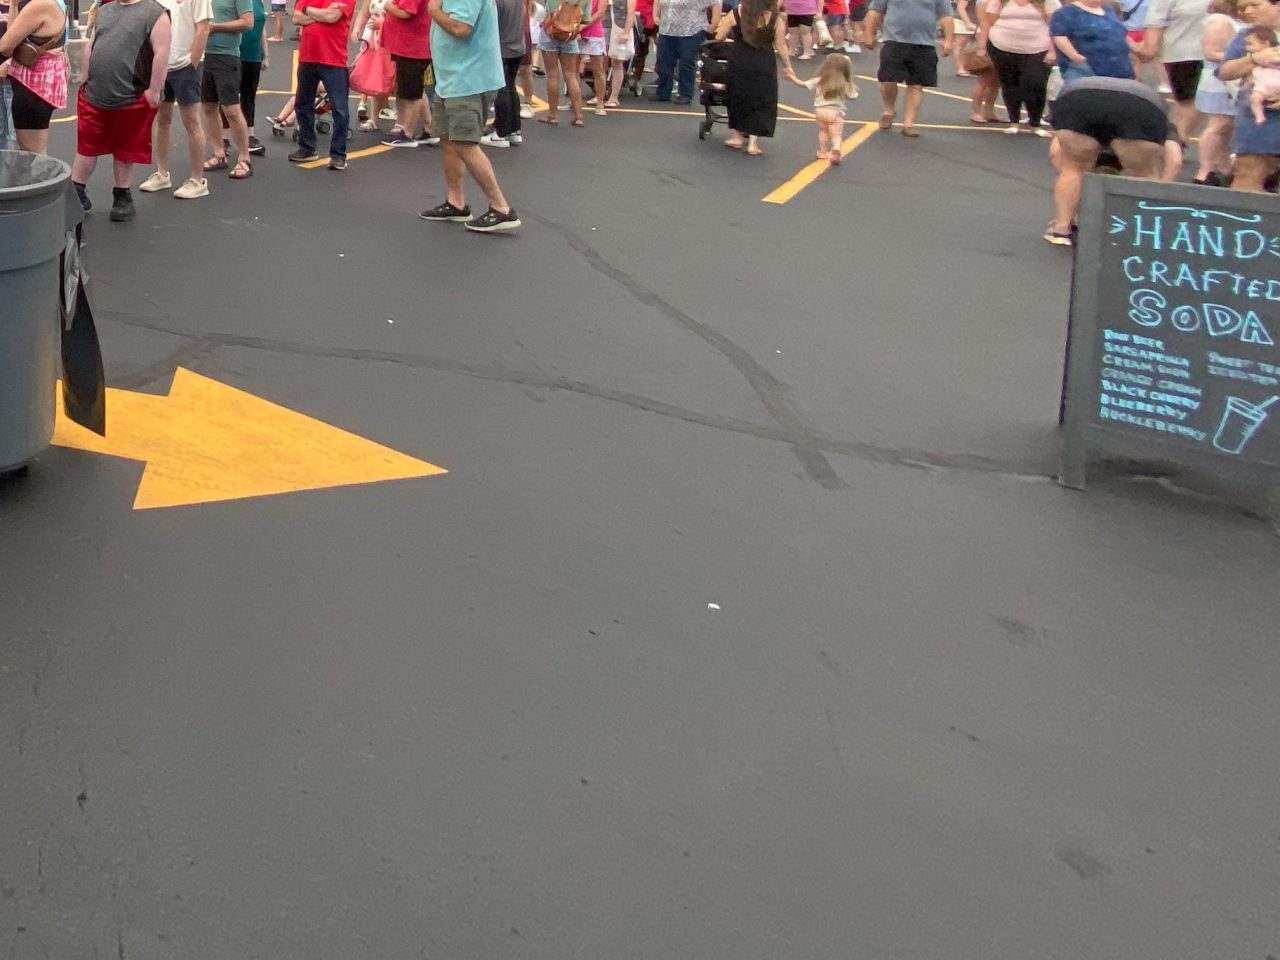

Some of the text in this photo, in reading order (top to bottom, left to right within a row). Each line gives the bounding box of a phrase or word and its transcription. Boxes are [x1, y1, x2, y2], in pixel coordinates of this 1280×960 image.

[1132, 214, 1265, 259] HAND
[1122, 255, 1280, 302] CRAFTED
[1128, 288, 1274, 345] SODA
[1101, 380, 1148, 398] BLACK
